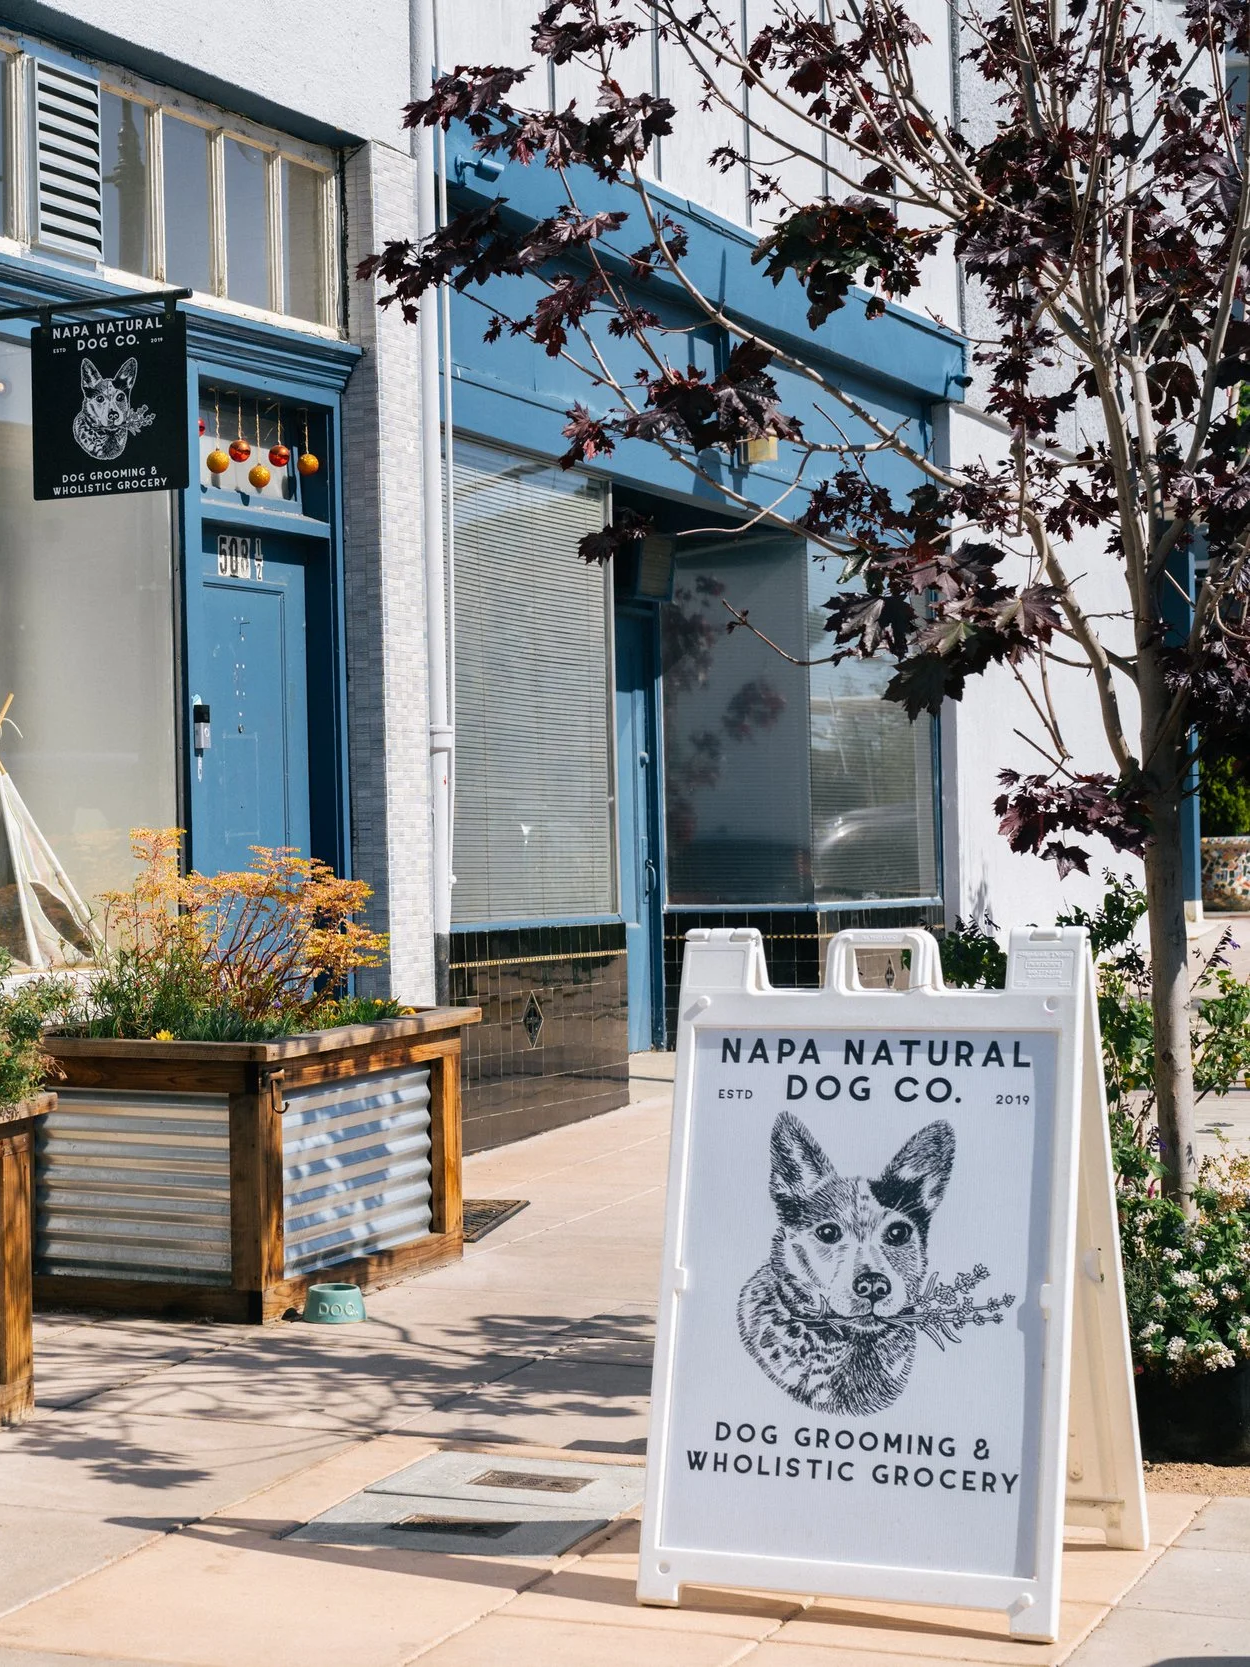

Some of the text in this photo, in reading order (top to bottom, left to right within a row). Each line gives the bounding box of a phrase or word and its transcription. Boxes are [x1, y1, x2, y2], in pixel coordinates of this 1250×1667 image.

[52, 317, 163, 339] NAPA NATURAL
[77, 334, 140, 351] DOG CO.
[62, 466, 158, 483] DOG GROOMING &
[53, 477, 168, 496] WHOLISTIC GROCERY
[219, 536, 249, 577] 508
[721, 1038, 1031, 1068] NAPA NATURAL
[718, 1088, 753, 1099] ESTD
[786, 1074, 962, 1103] DOG CO.
[996, 1094, 1030, 1106] 2019
[318, 1302, 359, 1317] DOG
[715, 1421, 990, 1460] DOG GROOMING &
[686, 1450, 1020, 1494] WHOLISTIC GROCERY
